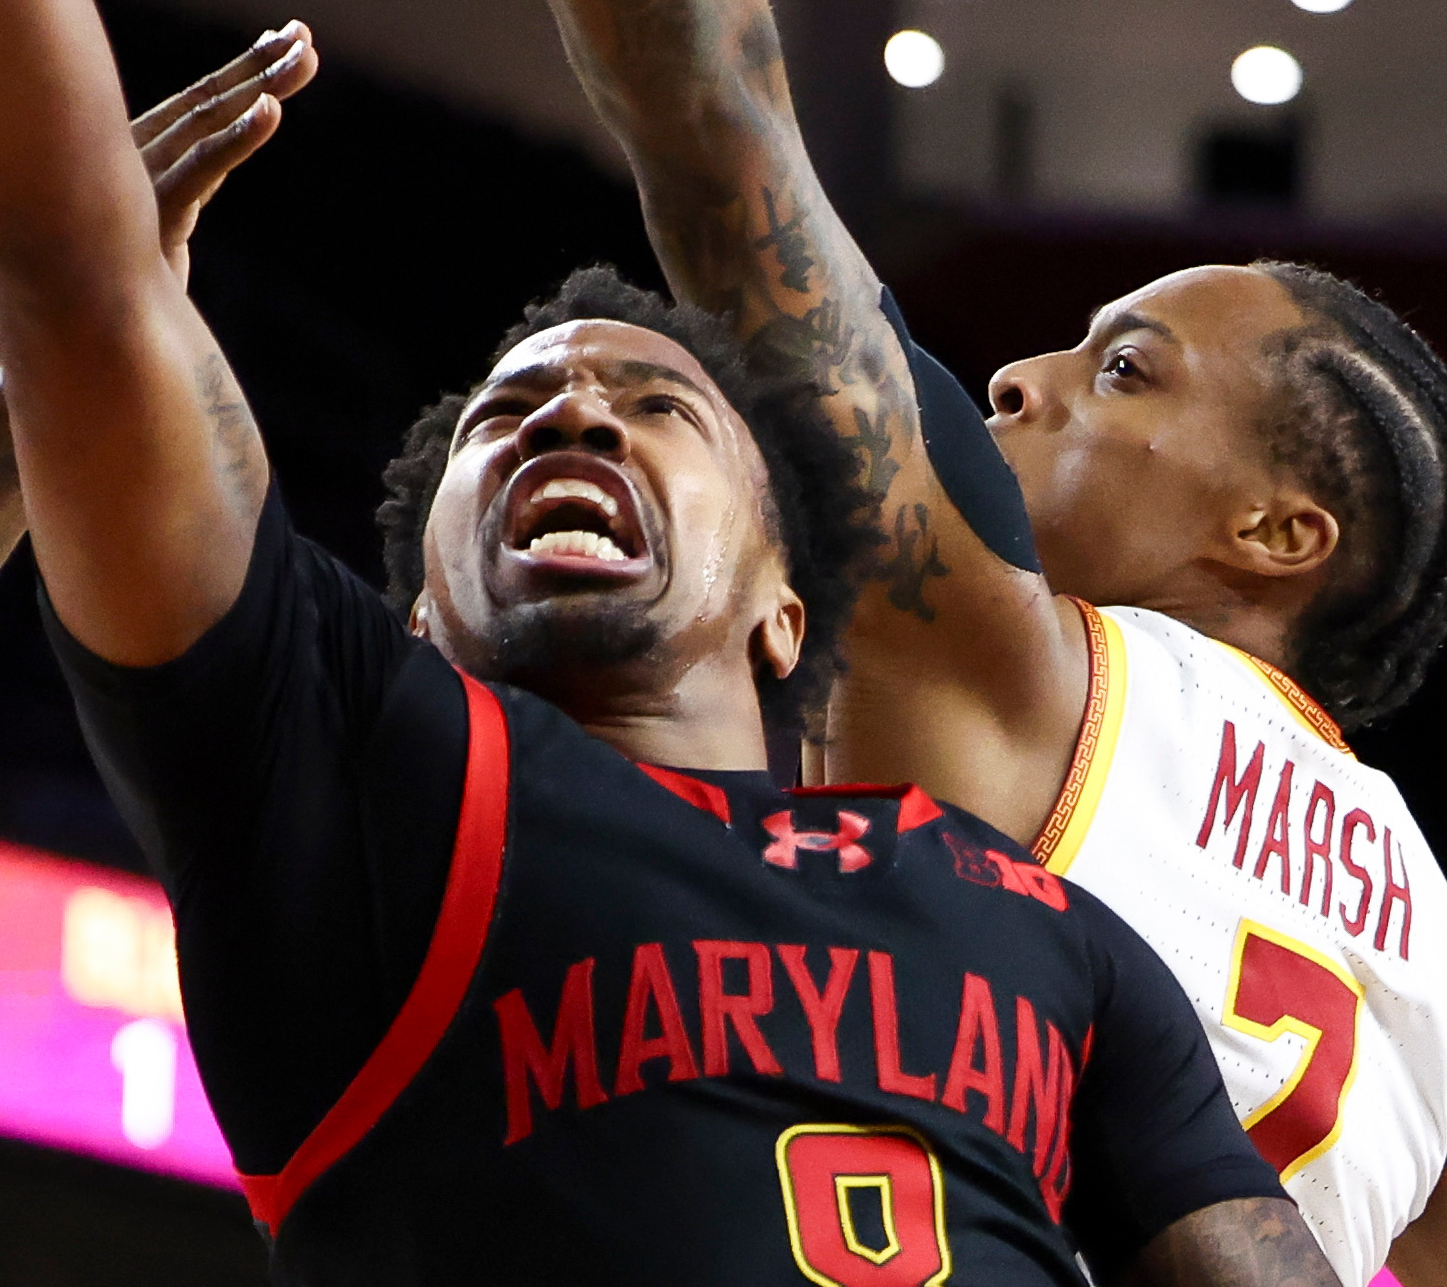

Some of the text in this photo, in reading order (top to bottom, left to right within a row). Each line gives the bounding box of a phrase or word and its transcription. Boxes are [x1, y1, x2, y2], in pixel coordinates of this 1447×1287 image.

[1195, 720, 1412, 962] MARSH
[111, 1018, 177, 1150] 1
[1221, 917, 1366, 1186] 7
